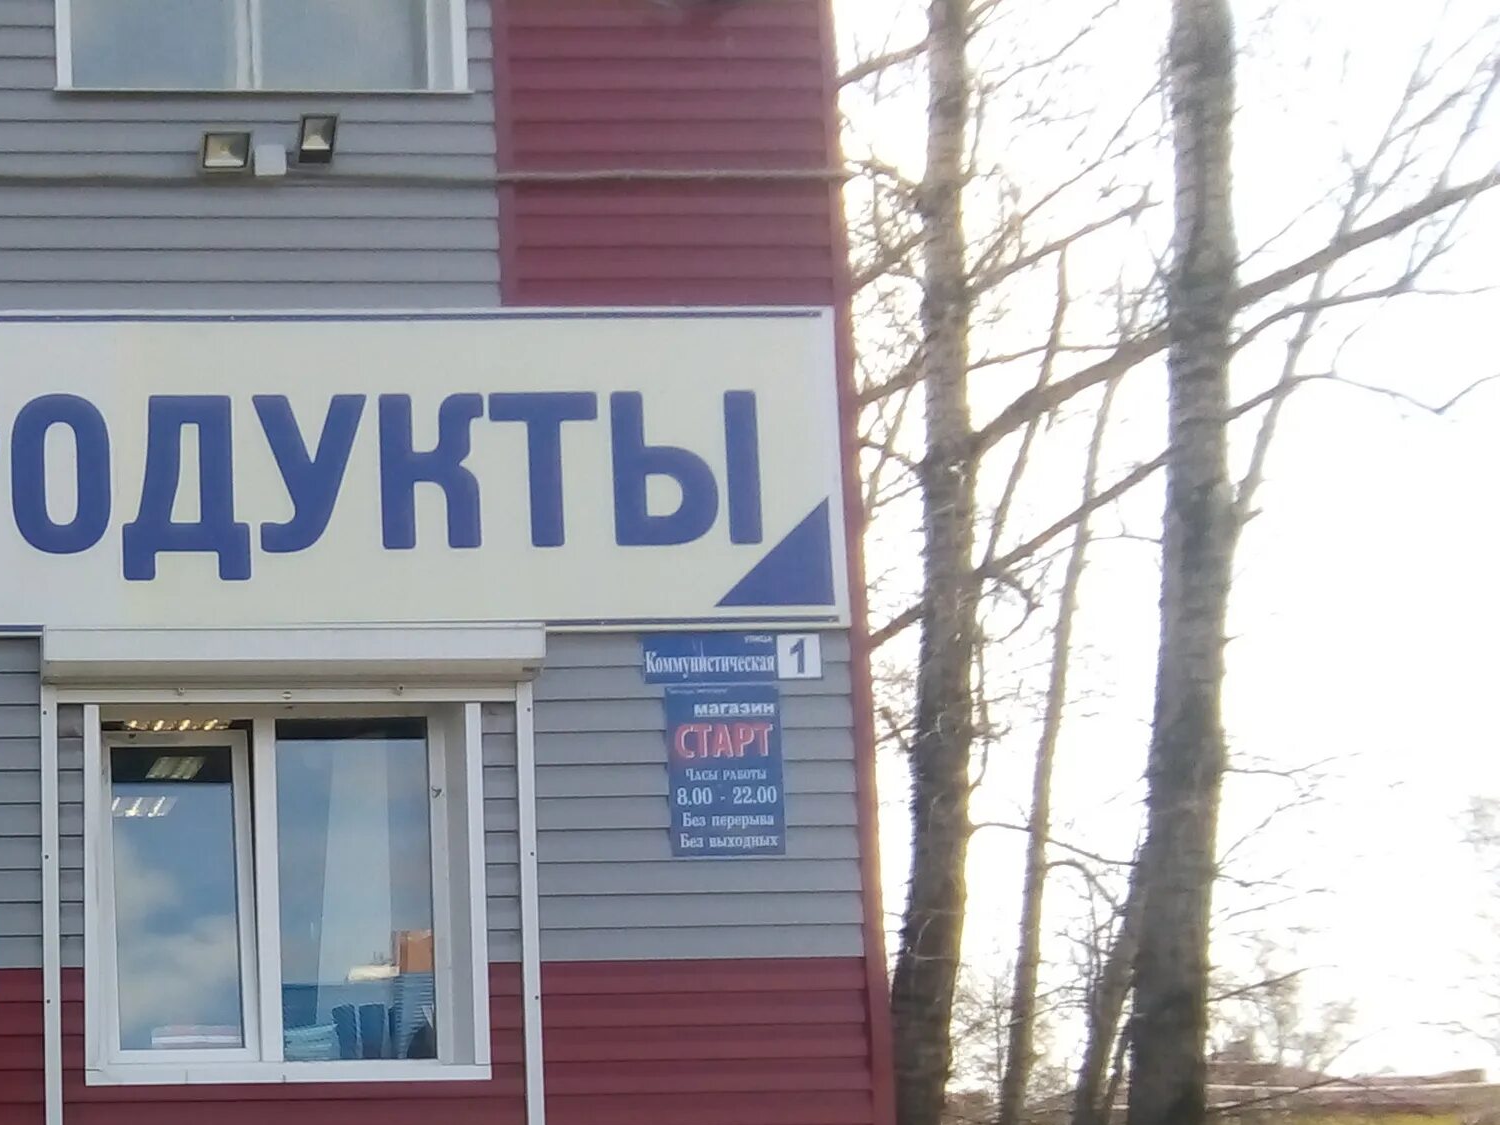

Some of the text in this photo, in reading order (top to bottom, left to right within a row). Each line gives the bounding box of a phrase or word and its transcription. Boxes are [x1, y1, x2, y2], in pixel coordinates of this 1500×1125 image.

[645, 651, 775, 678] Коммунистическая
[789, 638, 806, 674] 1
[693, 703, 775, 717] магазин
[675, 723, 774, 758] СТАРТ
[677, 787, 712, 806] 8.00
[732, 786, 777, 804] 22.00
[682, 812, 775, 829] Без перерыва
[680, 833, 779, 849] Без выходных
